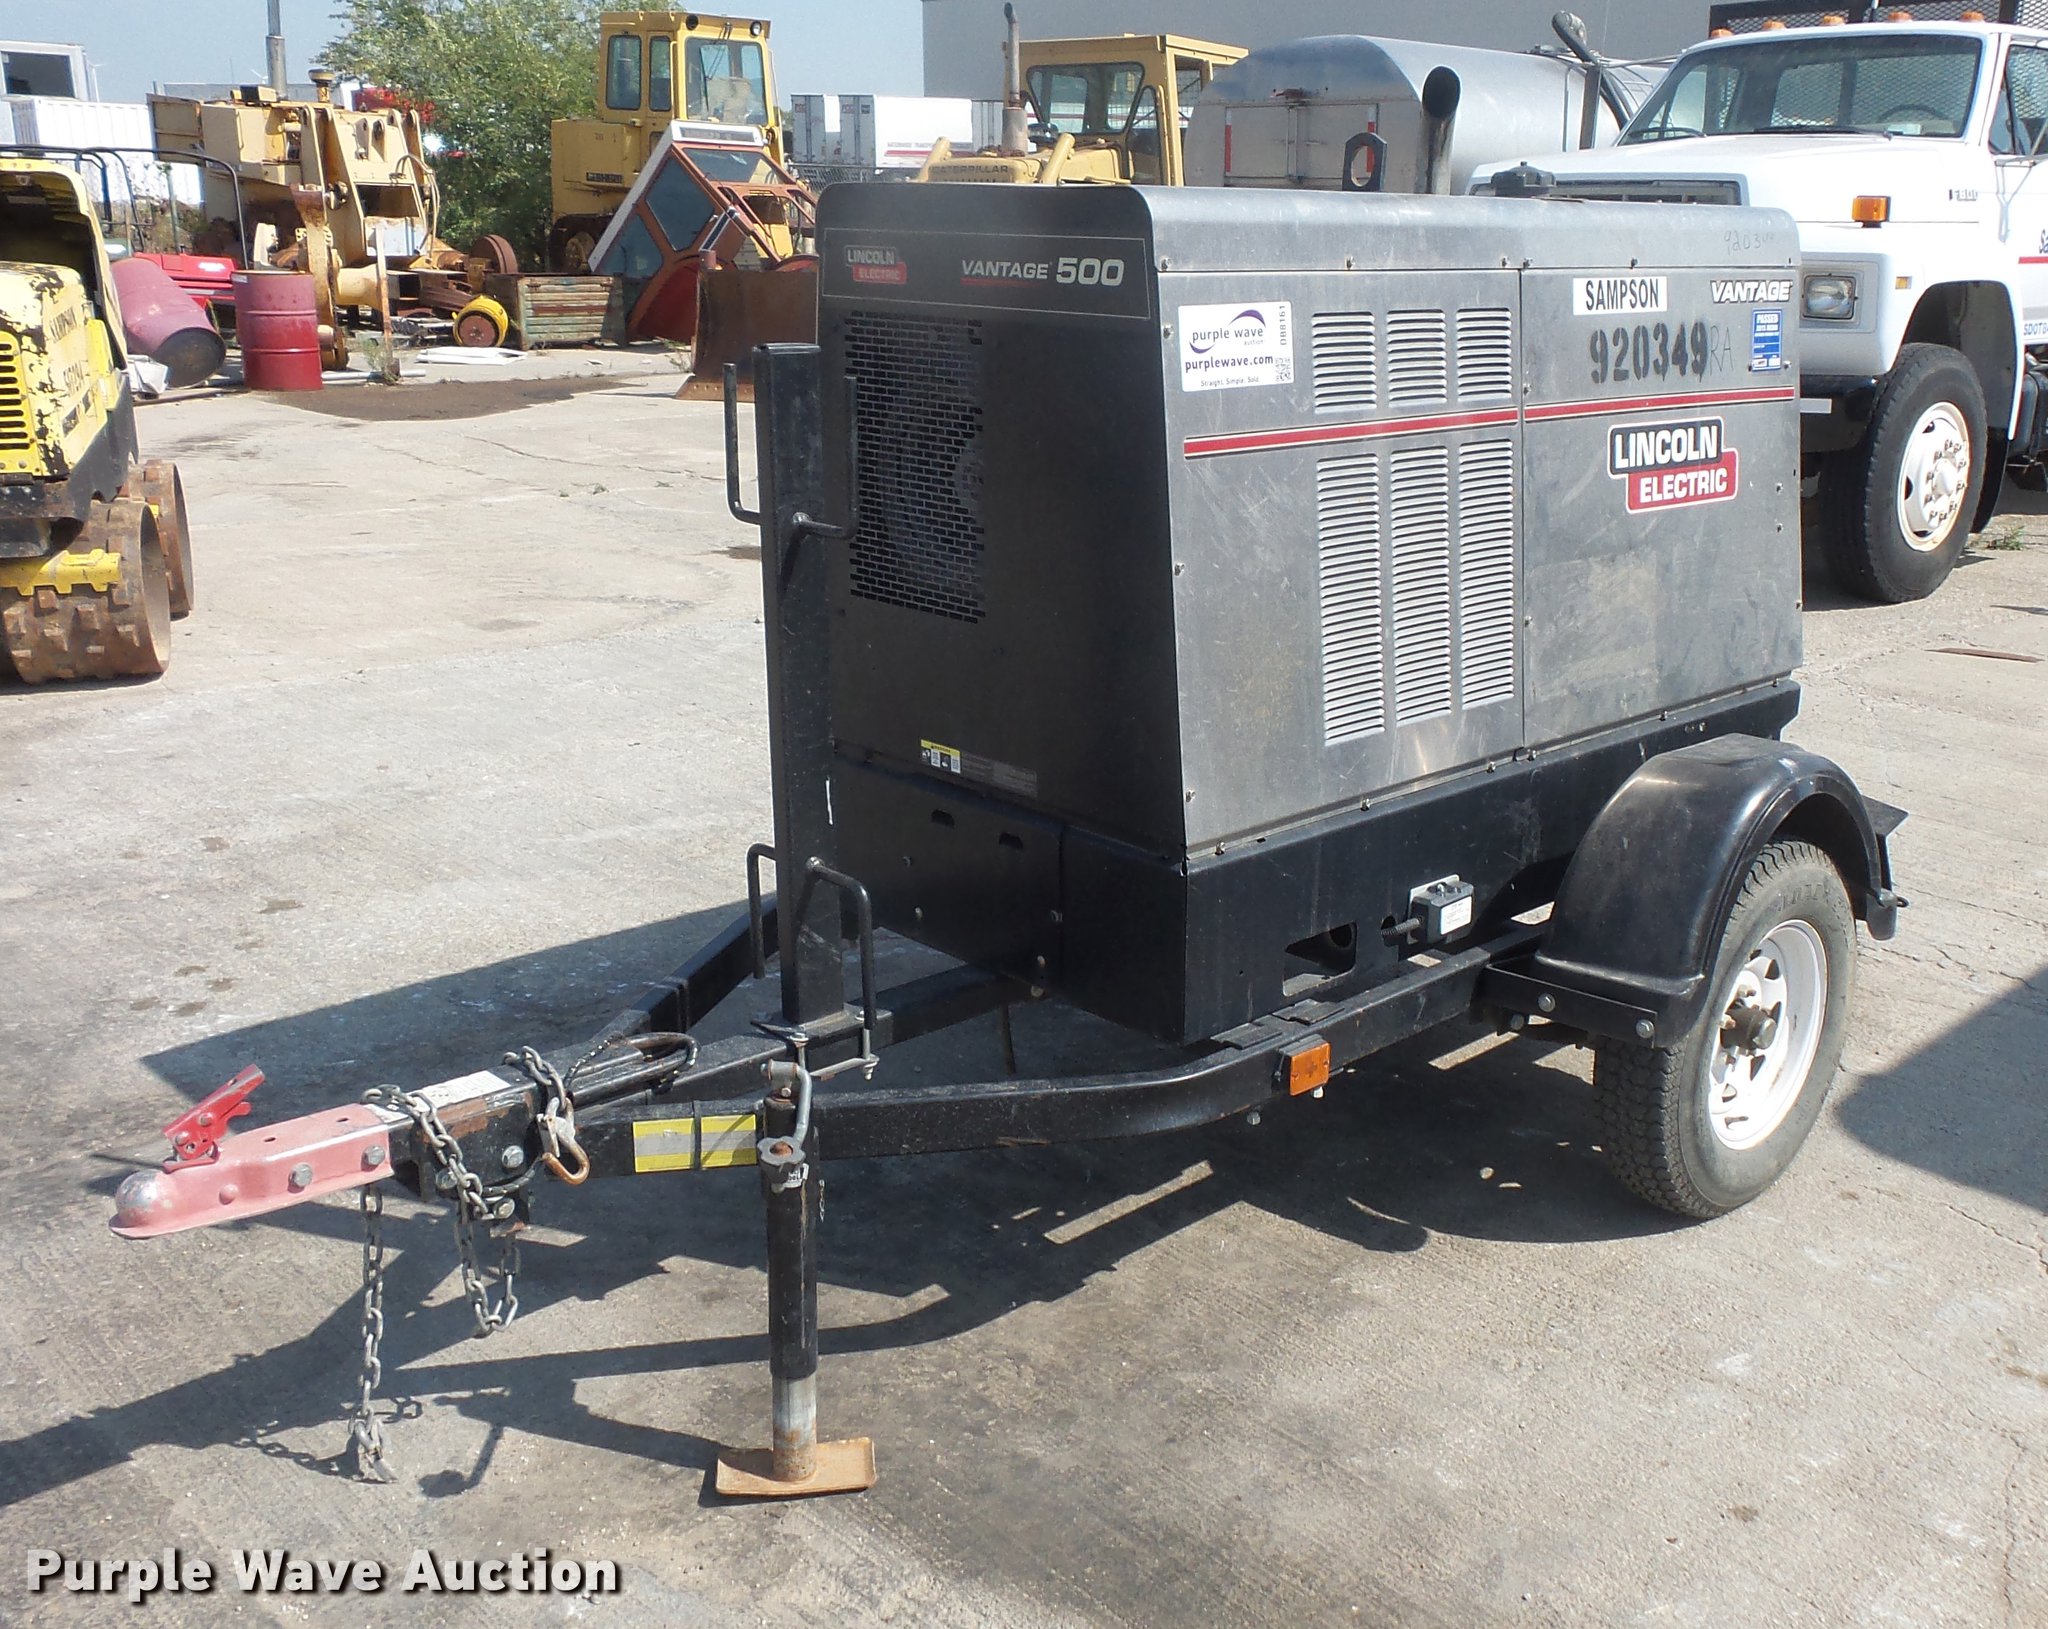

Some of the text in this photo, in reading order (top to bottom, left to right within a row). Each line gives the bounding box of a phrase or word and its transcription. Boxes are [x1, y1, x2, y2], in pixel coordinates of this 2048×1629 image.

[931, 165, 1009, 173] CATERPILLAR
[847, 249, 895, 265] LINCOLN
[858, 268, 901, 281] ELECTRIC
[961, 257, 1125, 287] VANTAGE 500
[1586, 279, 1659, 311] SAMPSON
[1711, 279, 1792, 303] VANTAGE
[1192, 328, 1264, 343] purple wave
[1185, 356, 1274, 373] purplewave.com
[1590, 322, 1708, 384] 920349
[1615, 425, 1718, 469] LINCOLN
[1640, 468, 1728, 503] ELECTRIC
